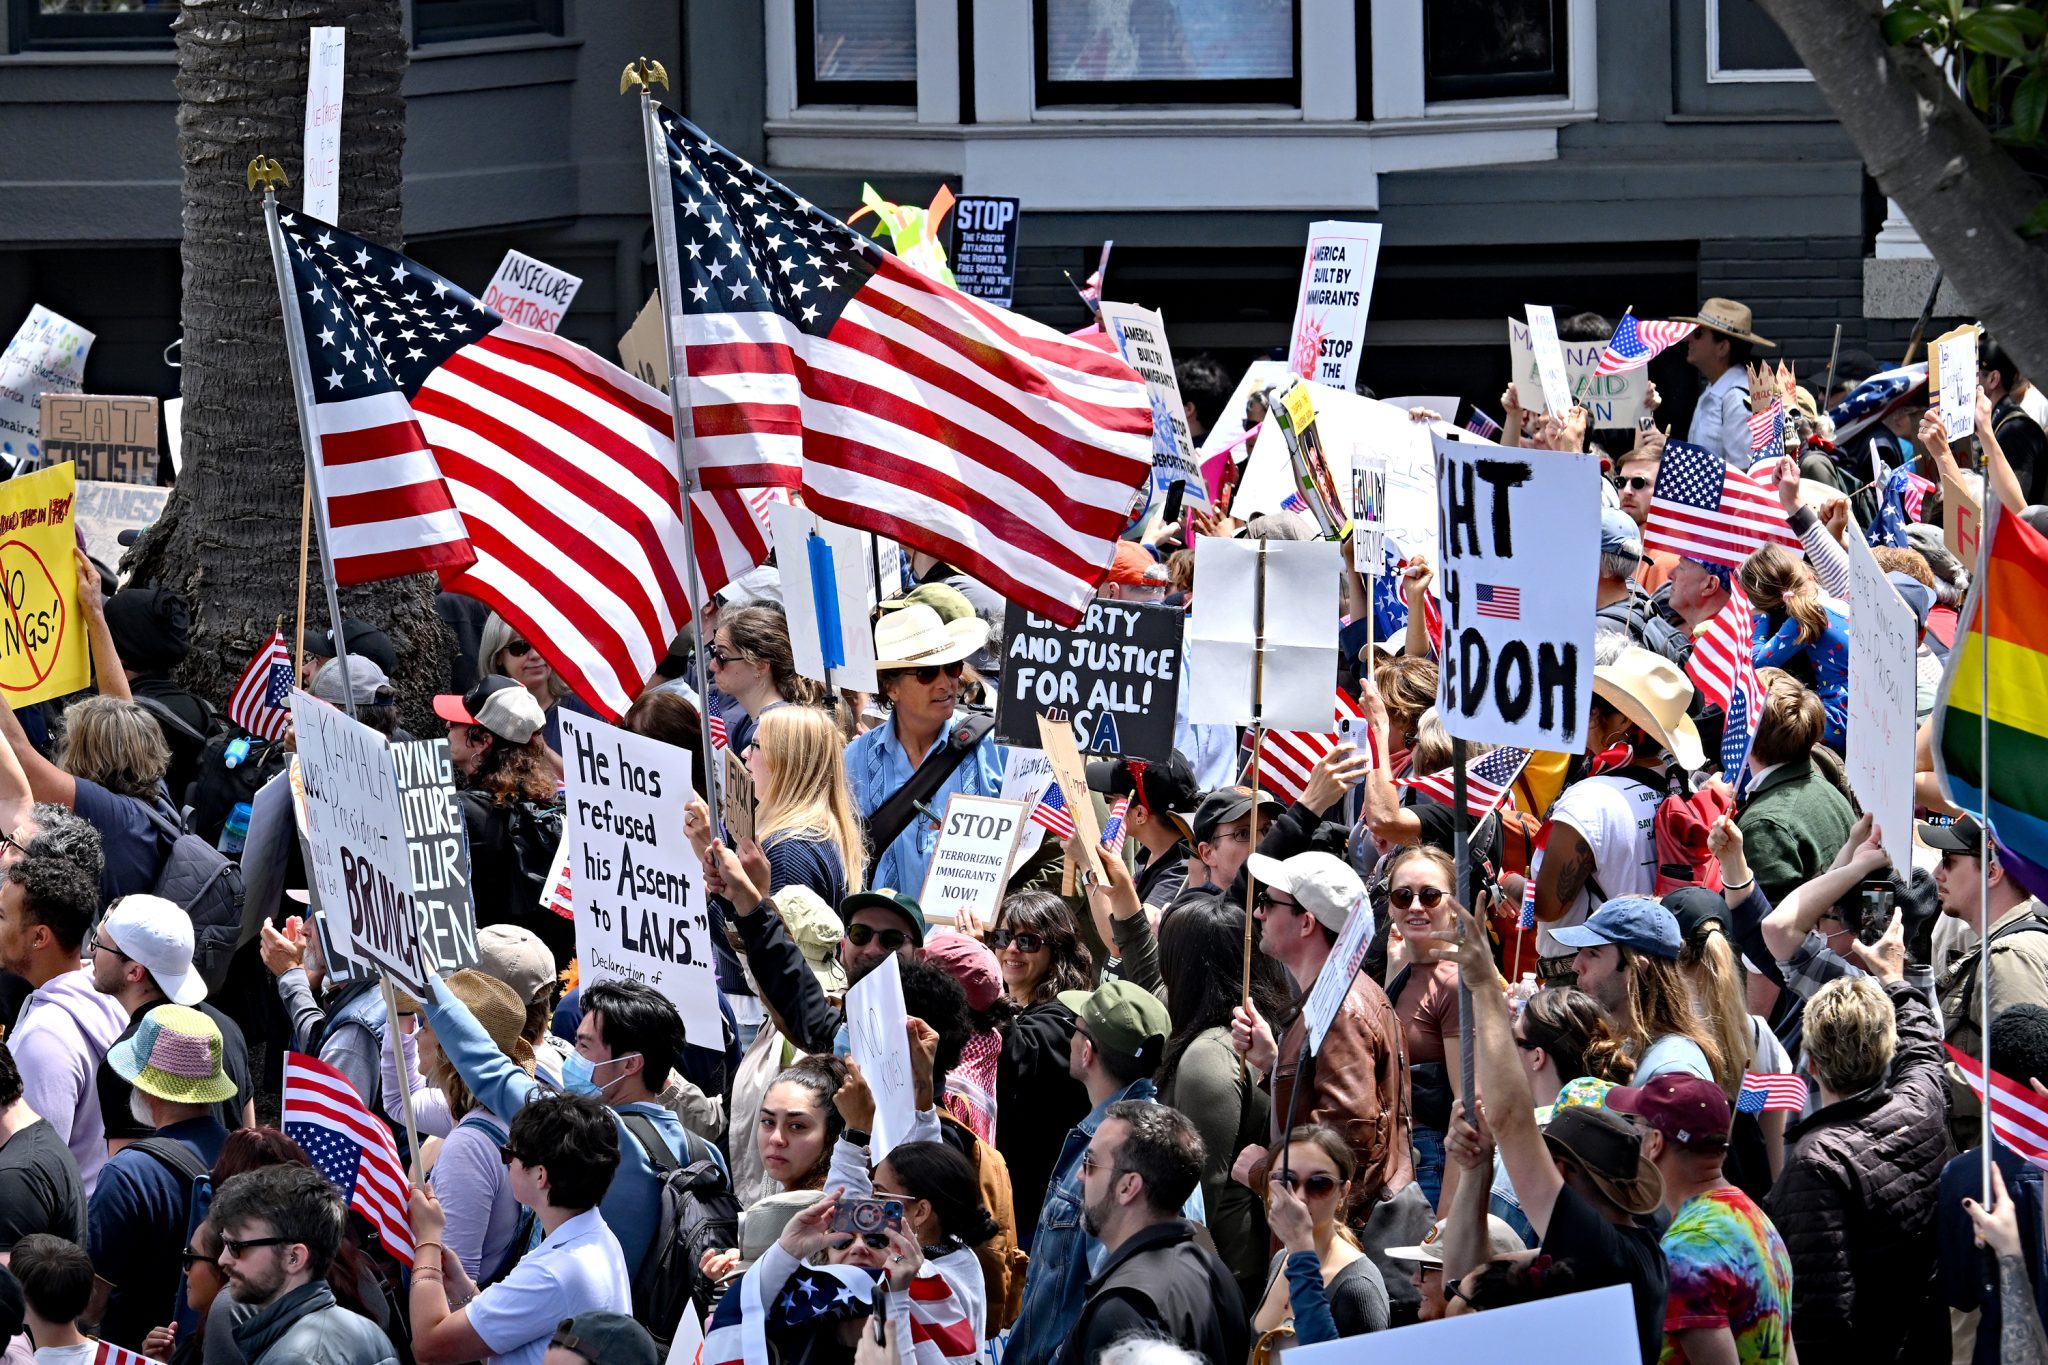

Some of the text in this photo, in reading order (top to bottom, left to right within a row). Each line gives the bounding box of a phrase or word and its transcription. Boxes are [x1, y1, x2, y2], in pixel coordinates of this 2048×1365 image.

[309, 157, 334, 189] RULE
[957, 200, 1014, 231] STOP
[1313, 246, 1345, 262] AMERICA
[501, 256, 575, 306] INSECURE
[1314, 267, 1351, 284] BUILT BY
[485, 285, 560, 333] DICTATORS
[1306, 289, 1360, 307] IMMIGRANTS
[1123, 326, 1155, 345] AMERICA
[1320, 339, 1353, 359] STOP
[1137, 347, 1163, 368] BUILT BY
[1322, 362, 1341, 378] THE
[50, 400, 150, 443] EAT
[1171, 416, 1187, 439] STOP
[1180, 439, 1190, 456] THE
[1152, 453, 1200, 478] DEPORTATIONS
[1010, 633, 1175, 681] AND JUSTICE
[1873, 633, 1903, 715] PRISON
[1016, 667, 1152, 715] FOR ALL!
[317, 707, 396, 813] KAMALA
[389, 738, 453, 789] DYING
[617, 742, 662, 799] has
[730, 761, 749, 816] FUCK
[1638, 791, 1656, 802] LOVE
[328, 776, 389, 862] President
[400, 786, 462, 839] UTURE
[577, 798, 657, 847] refused
[947, 812, 1013, 841] STOP
[1638, 818, 1651, 829] SAY
[583, 841, 691, 907] his Assent
[935, 866, 997, 882] IMMIGRANTS
[940, 849, 1003, 867] TERRORIZING
[327, 871, 339, 899] be
[941, 885, 979, 902] NOW!
[340, 845, 428, 984] BRUNCH
[590, 900, 611, 932] to
[591, 947, 663, 985] Declaration of
[856, 1007, 883, 1064] NO
[880, 1050, 905, 1102] KINGS
